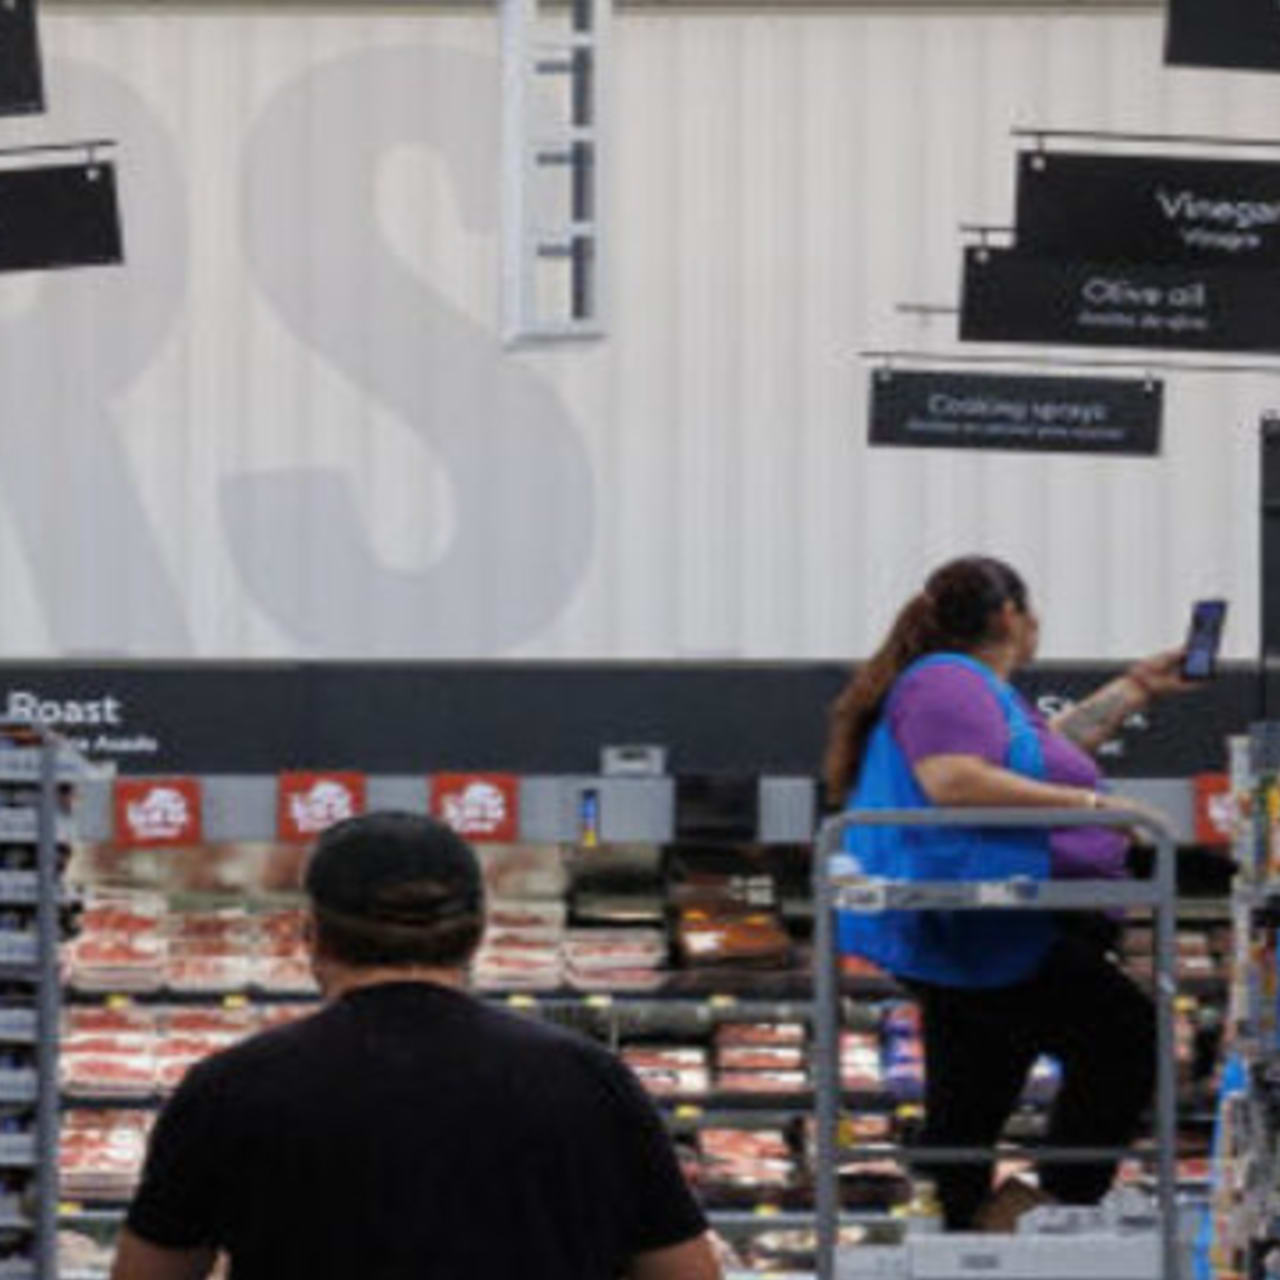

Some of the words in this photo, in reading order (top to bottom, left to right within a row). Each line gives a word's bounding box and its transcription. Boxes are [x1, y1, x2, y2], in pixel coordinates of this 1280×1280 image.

[1082, 278, 1162, 305] Olive
[1168, 283, 1205, 306] oil
[8, 692, 120, 724] Roast
